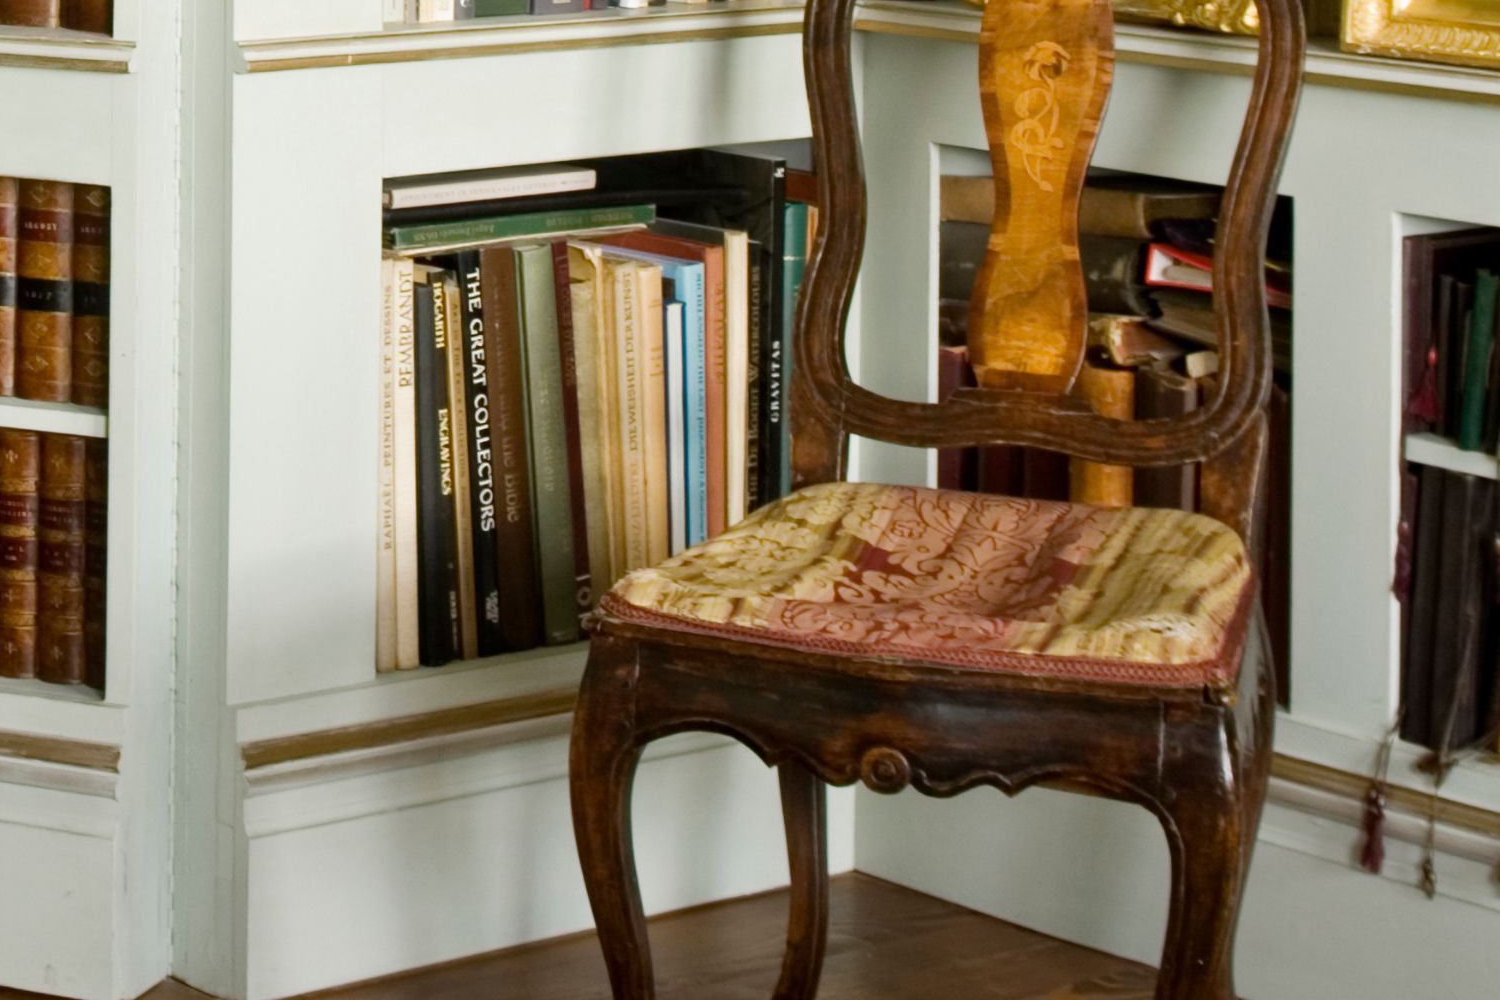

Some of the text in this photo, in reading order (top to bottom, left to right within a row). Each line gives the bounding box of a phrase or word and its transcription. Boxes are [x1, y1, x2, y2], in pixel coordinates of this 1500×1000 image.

[398, 270, 413, 388] REMBRANDT
[433, 281, 446, 349] HOGARTH
[466, 267, 496, 532] THE GREAT COLLECTORS
[770, 340, 782, 423] GRAVITAS
[437, 408, 451, 496] ENGRAVINGS
